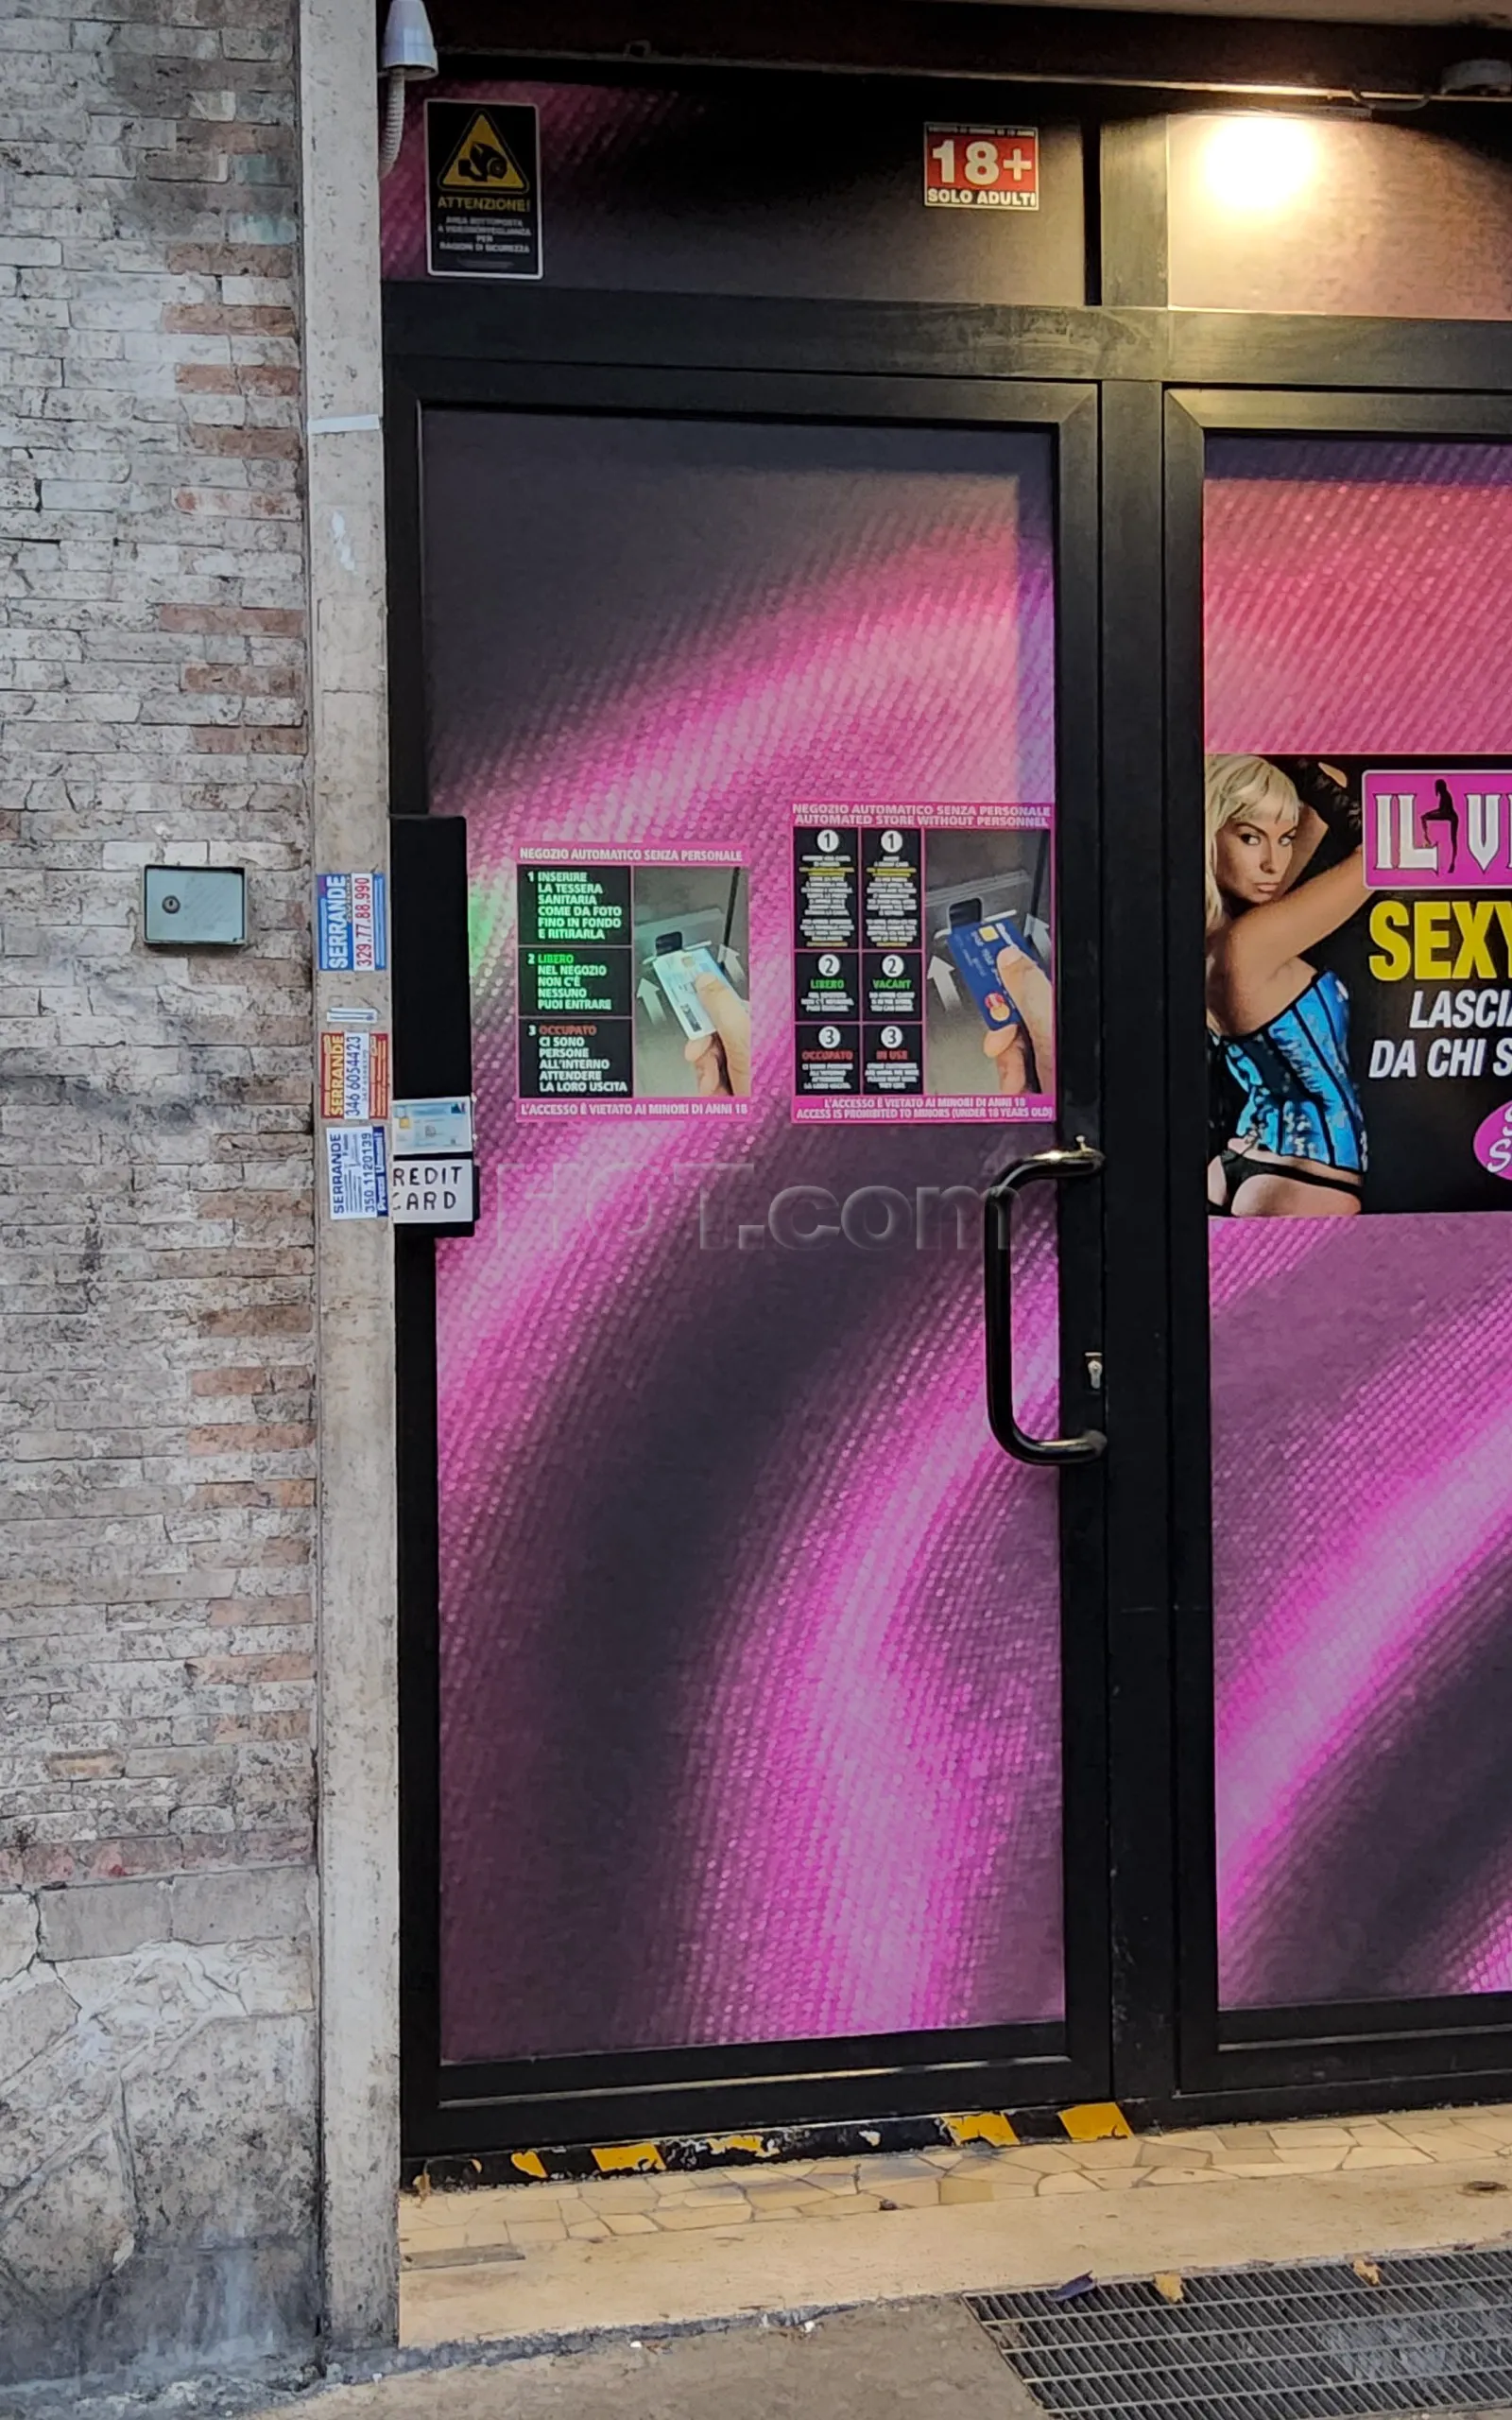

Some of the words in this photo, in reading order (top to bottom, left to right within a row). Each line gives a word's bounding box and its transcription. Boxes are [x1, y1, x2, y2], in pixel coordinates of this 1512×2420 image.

[933, 140, 1032, 185] 18+
[928, 188, 972, 203] SOLO
[977, 190, 1036, 206] ADULTI
[792, 804, 849, 814] NEGOZIO
[851, 804, 934, 815] AUTOMATICO
[936, 805, 975, 816] SENZA
[979, 806, 1051, 817] PERSONALE
[795, 814, 873, 824] AUTOMATED
[876, 815, 915, 825] STORE
[918, 816, 973, 826] WITHOUT
[1373, 793, 1438, 874] IL
[823, 833, 831, 848] 1
[887, 833, 896, 849] 1
[520, 848, 568, 859] NEGOZIO
[571, 849, 641, 860] AUTOMATICO
[644, 850, 678, 861] SENZA
[681, 850, 742, 861] PERSONALE
[528, 872, 534, 882] 1
[538, 872, 588, 882] INSERIRE
[538, 883, 553, 893] LA
[556, 884, 603, 894] TESSERA
[538, 894, 597, 905] SANITARIA
[538, 906, 571, 916] COME
[574, 907, 591, 916] DA
[593, 907, 622, 917] FOTO
[326, 875, 348, 968] SERRANDE
[354, 877, 371, 966] 329.77.88.990
[538, 918, 565, 927] FINO
[567, 918, 579, 927] IN
[582, 918, 622, 928] FONDO
[538, 928, 545, 939] E
[548, 929, 605, 939] RITIRARLA
[528, 954, 535, 964] 2
[538, 953, 574, 963] LIBERO
[538, 965, 558, 976] NEL
[560, 965, 607, 976] NEGOZIO
[825, 958, 833, 974] 2
[888, 958, 897, 974] 2
[538, 977, 561, 987] NON
[564, 975, 580, 987] C'È
[538, 988, 587, 998] NESSUNO
[538, 999, 564, 1010] PUOI
[566, 999, 611, 1010] ENTRARE
[528, 1026, 536, 1036] 3
[540, 1025, 597, 1036] OCCUPATO
[825, 1029, 833, 1045] 3
[887, 1028, 896, 1045] 3
[540, 1037, 550, 1047] CI
[553, 1037, 585, 1047] SONO
[540, 1048, 590, 1059] PERSONE
[1368, 1039, 1417, 1078] DA
[1427, 1038, 1486, 1078] CHI
[540, 1060, 610, 1070] ALL'INTERNO
[331, 1035, 344, 1115] SERRANDE
[540, 1070, 602, 1080] ATTENDERE
[540, 1081, 555, 1092] LA
[557, 1081, 587, 1093] LORO
[590, 1081, 627, 1093] USCITA
[346, 1093, 360, 1115] 346
[522, 1104, 577, 1115] L'ACCESSO
[580, 1102, 587, 1115] È
[590, 1104, 631, 1115] VIETATO
[635, 1104, 646, 1115] AI
[692, 1104, 703, 1115] DI
[705, 1104, 732, 1115] ANNI
[330, 1132, 344, 1214] SERRANDE
[393, 1167, 463, 1187] REDIT
